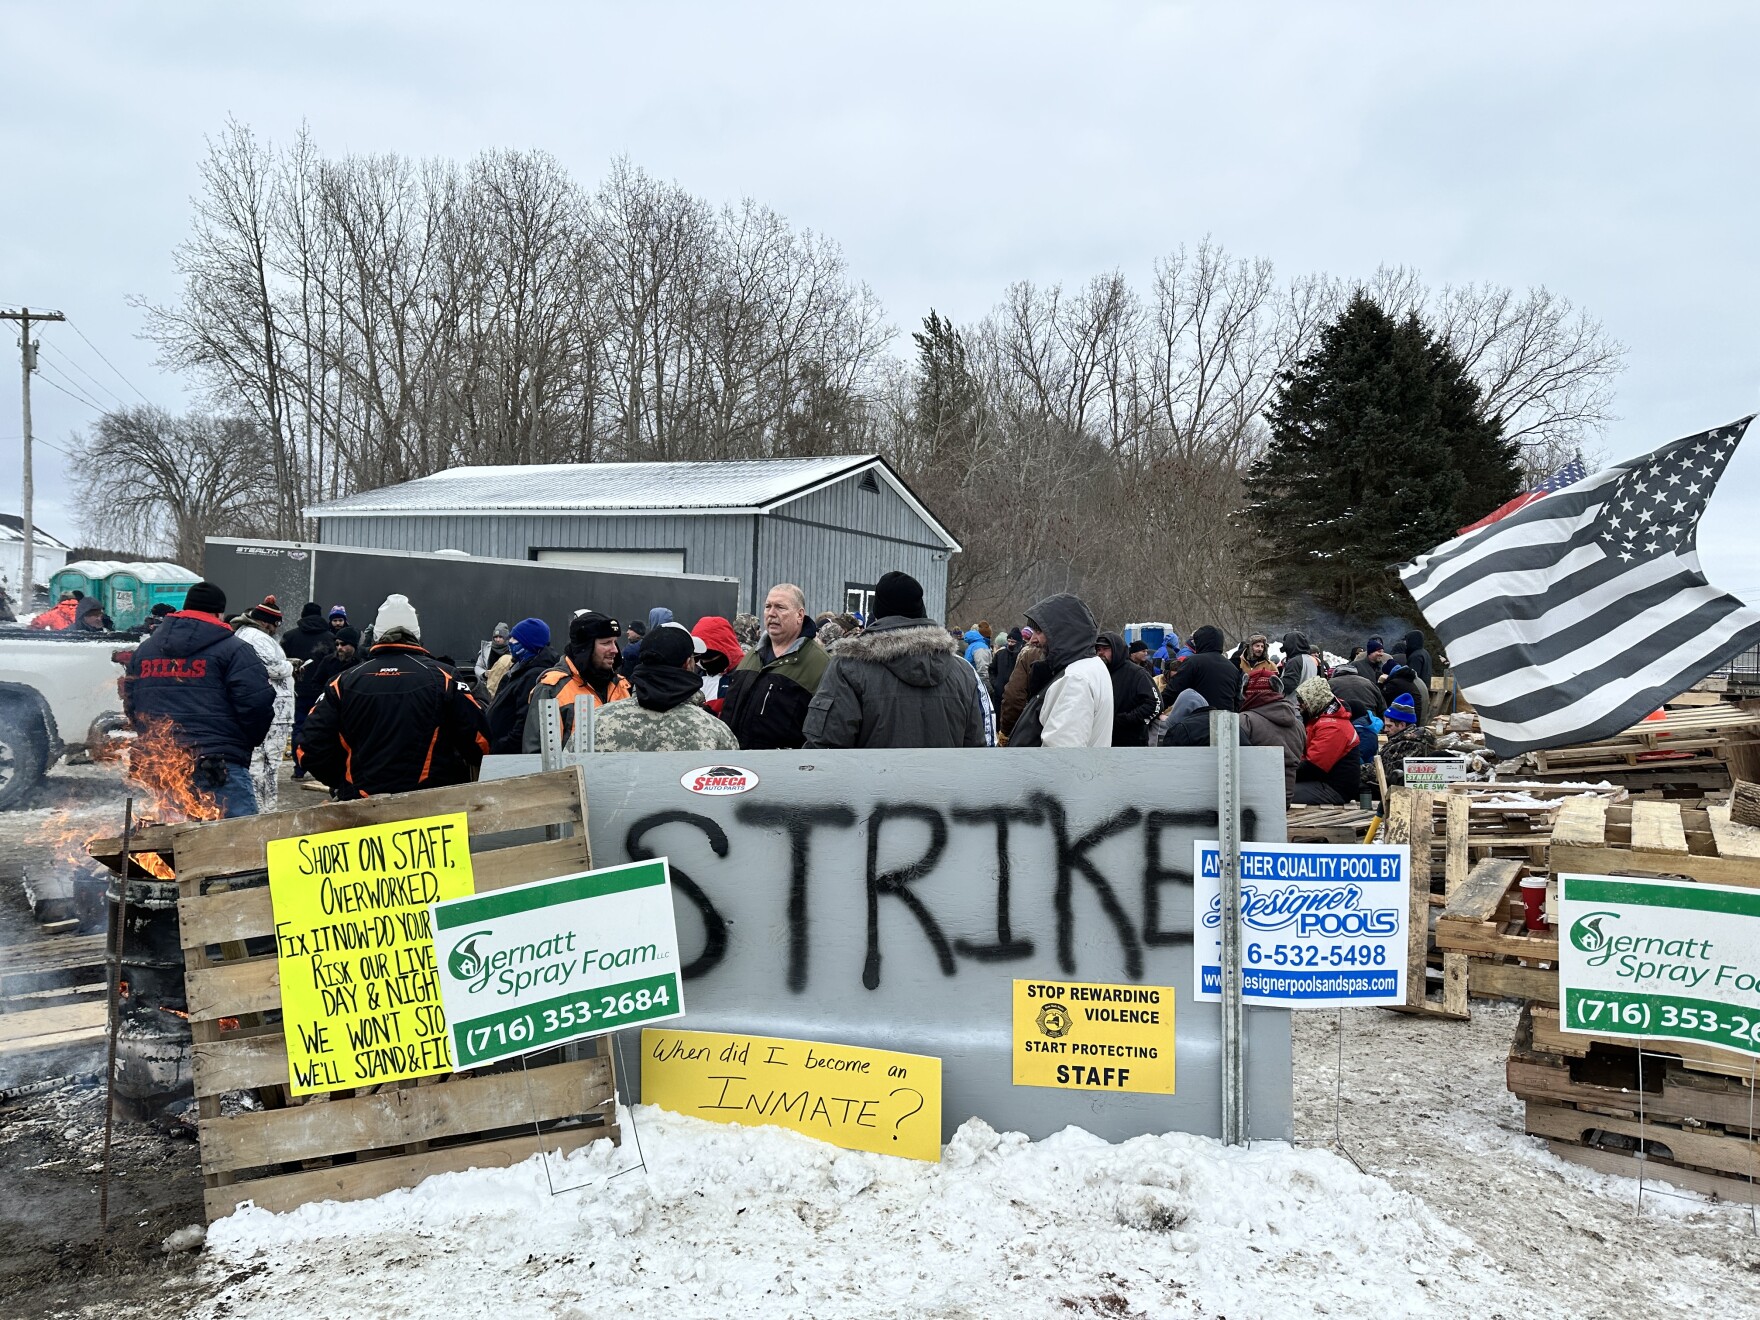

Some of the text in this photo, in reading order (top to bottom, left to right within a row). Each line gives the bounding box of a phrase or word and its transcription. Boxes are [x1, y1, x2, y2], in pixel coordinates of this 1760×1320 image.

[236, 547, 279, 555] STEALTH
[141, 658, 207, 678] BILLS
[693, 776, 746, 791] SENECA
[299, 824, 455, 875] SHORT ON STAFF,
[1204, 853, 1399, 878] ANHER QUALITY POOL BY
[320, 871, 441, 915] OVERWORKED,
[626, 792, 1256, 994] STRIKE
[395, 910, 433, 942] YOUR
[1300, 911, 1397, 936] POOLS
[1570, 911, 1713, 967] Gernatt
[448, 930, 576, 994] Gernatt
[1216, 941, 1386, 966] 6-532-5498
[312, 953, 353, 989] RISK
[360, 953, 390, 981] OUR
[497, 943, 670, 997] Spray Foam LLC
[1616, 954, 1760, 993] Spray Fo
[321, 969, 441, 1017] DAY & NIGH
[1027, 984, 1160, 1004] STOP REWARDING
[466, 985, 670, 1057] (716) 353-2684
[1084, 1008, 1160, 1024] VIOLENCE
[1577, 998, 1651, 1028] (716)
[297, 1021, 333, 1054] WE
[346, 1011, 401, 1051] WON'T
[652, 1038, 907, 1079] When did I become an
[1025, 1041, 1158, 1059] START PROTECTING
[293, 1059, 346, 1088] WE'LL
[1056, 1064, 1130, 1087] STAFF
